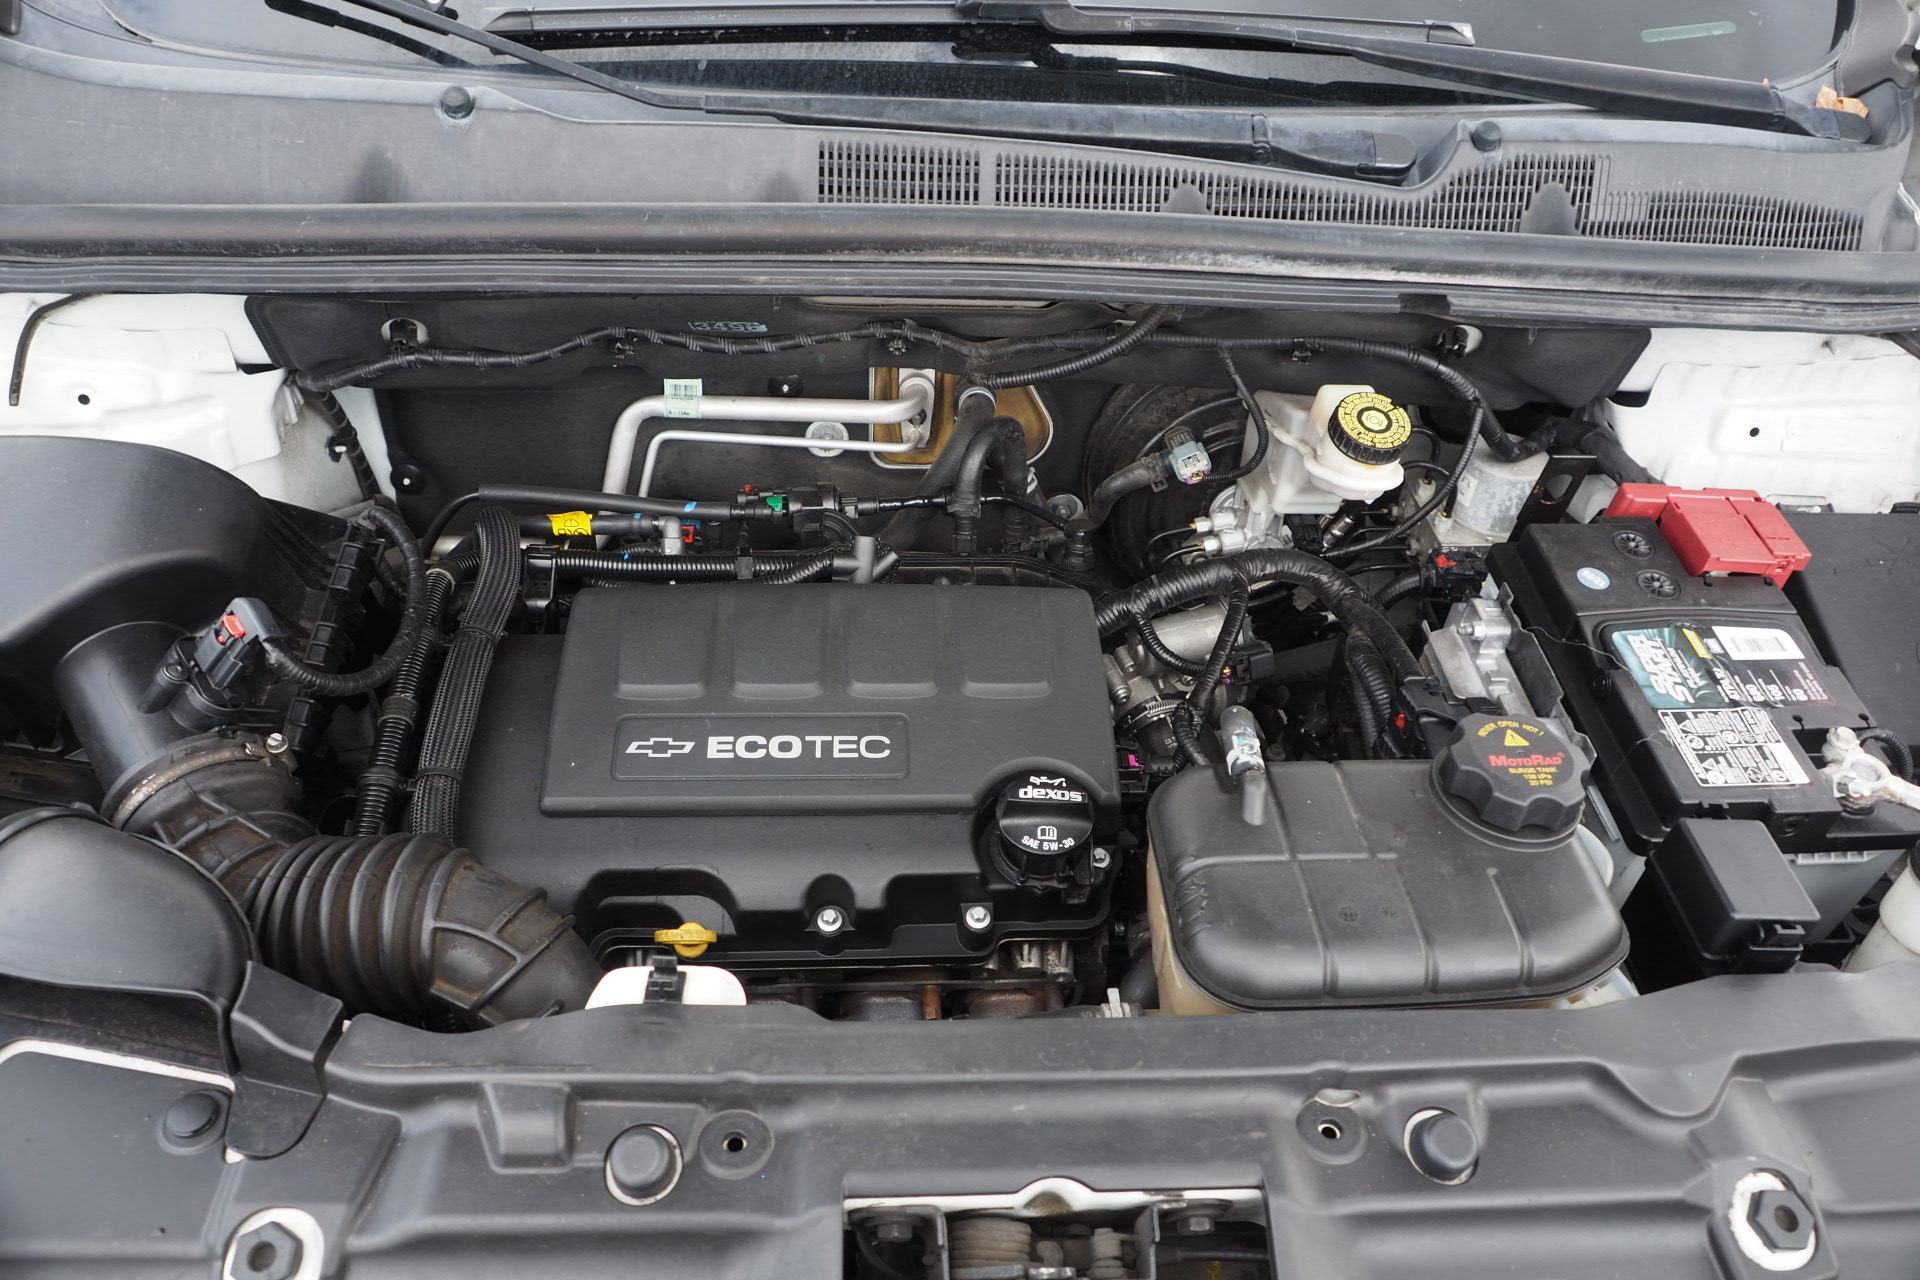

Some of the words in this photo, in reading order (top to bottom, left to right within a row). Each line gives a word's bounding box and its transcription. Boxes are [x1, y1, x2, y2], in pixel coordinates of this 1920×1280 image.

[1626, 634, 1668, 694] SUPER
[1643, 636, 1695, 702] START
[1767, 684, 1785, 700] 105
[1792, 689, 1808, 701] 60
[707, 735, 890, 758] ECOTEC
[1019, 786, 1082, 801] dexos
[1022, 836, 1040, 849] SAE
[1043, 838, 1075, 850] 5W-30
